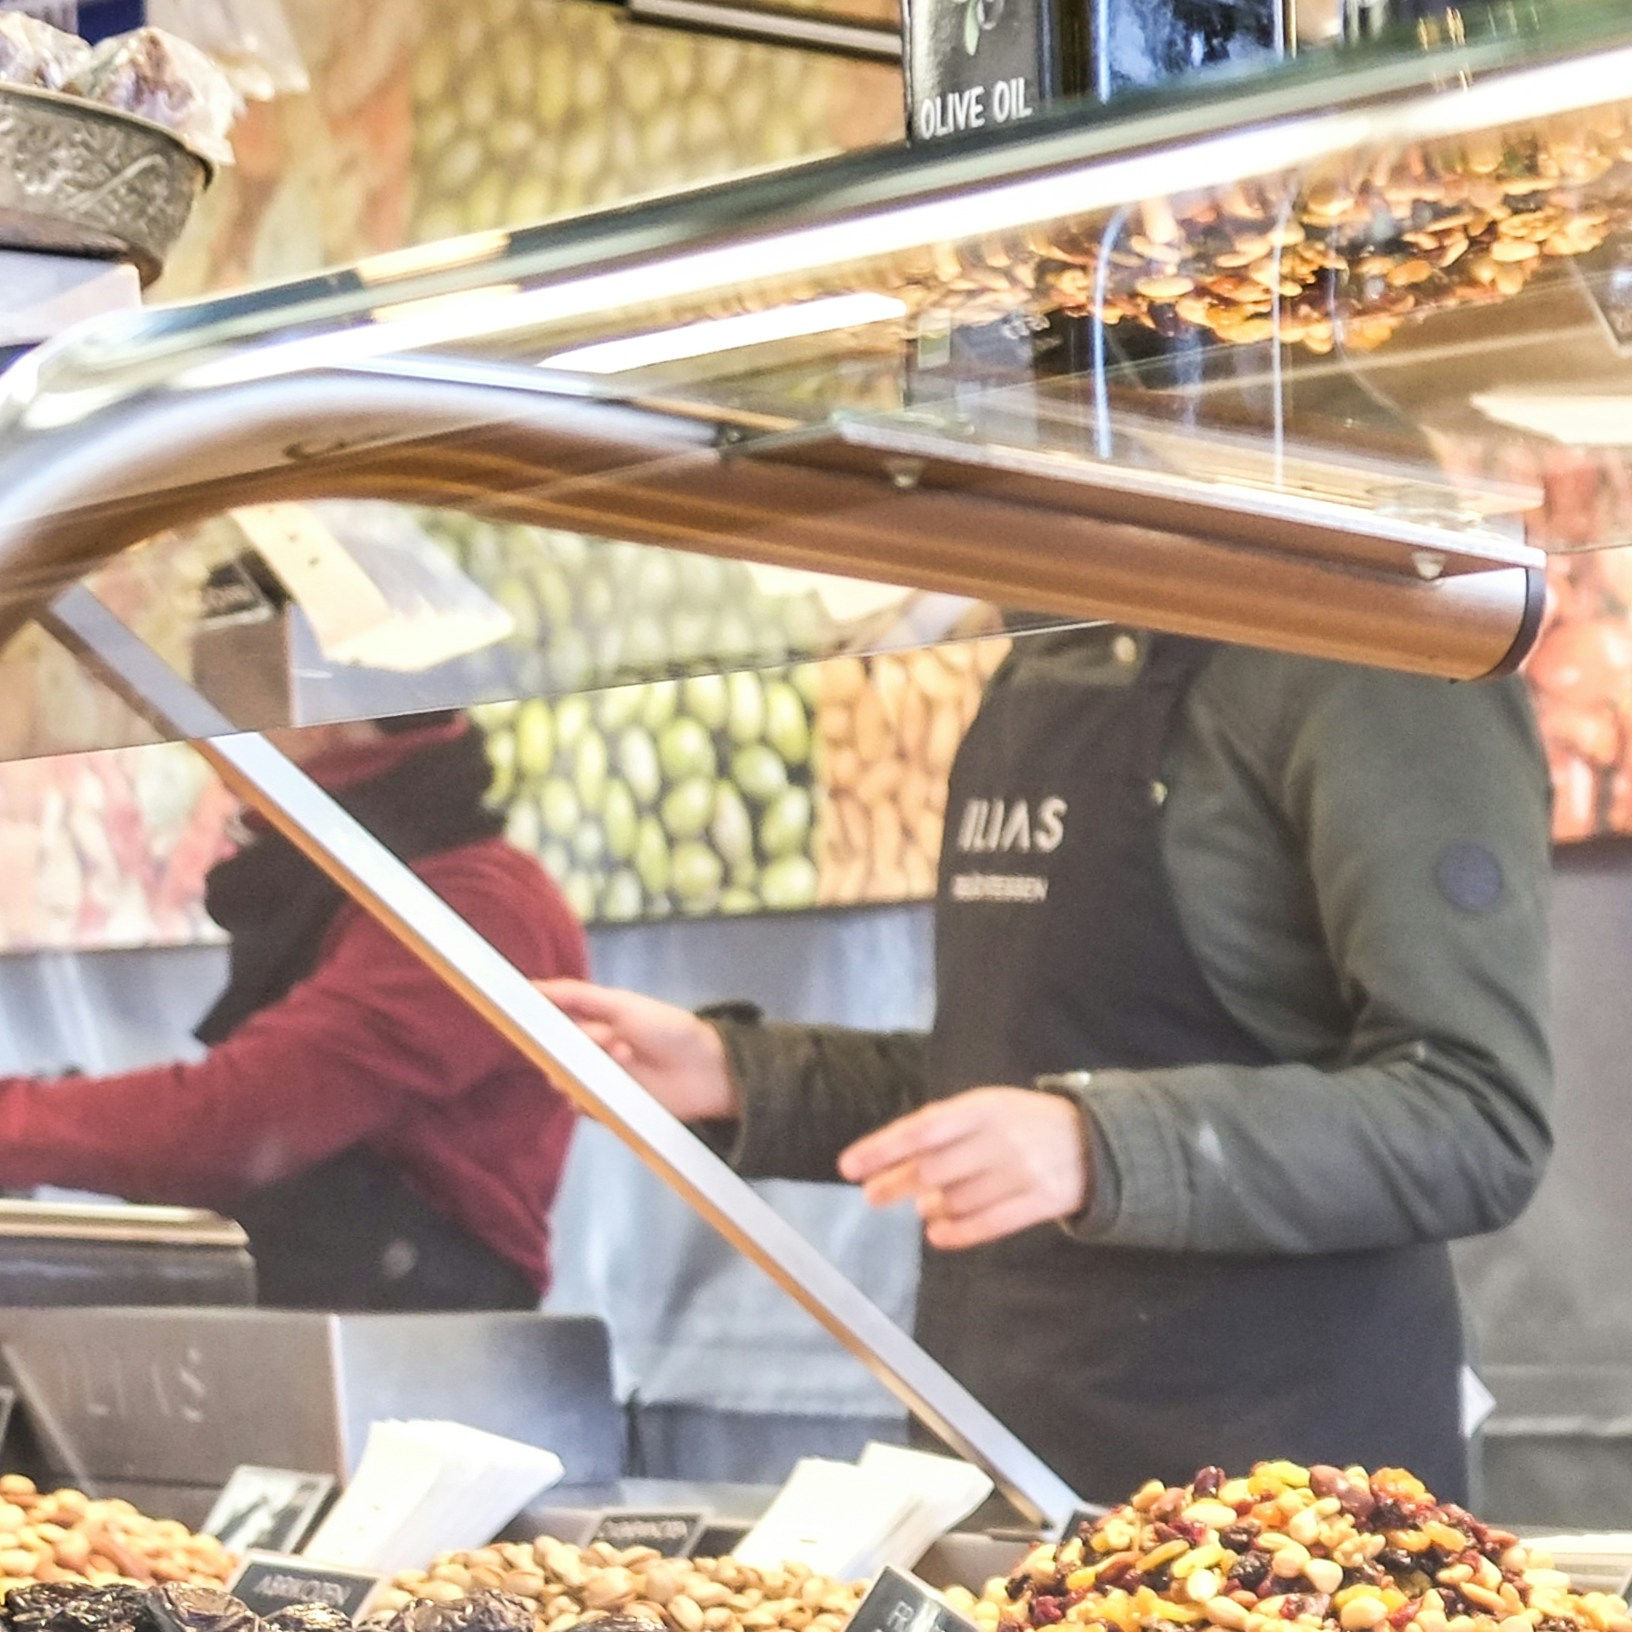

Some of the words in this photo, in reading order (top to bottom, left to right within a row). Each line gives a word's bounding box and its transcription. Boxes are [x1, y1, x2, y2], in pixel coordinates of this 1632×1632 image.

[921, 86, 985, 140] OLIVE
[993, 77, 1033, 123] OIL
[957, 796, 1068, 853] ILIAS
